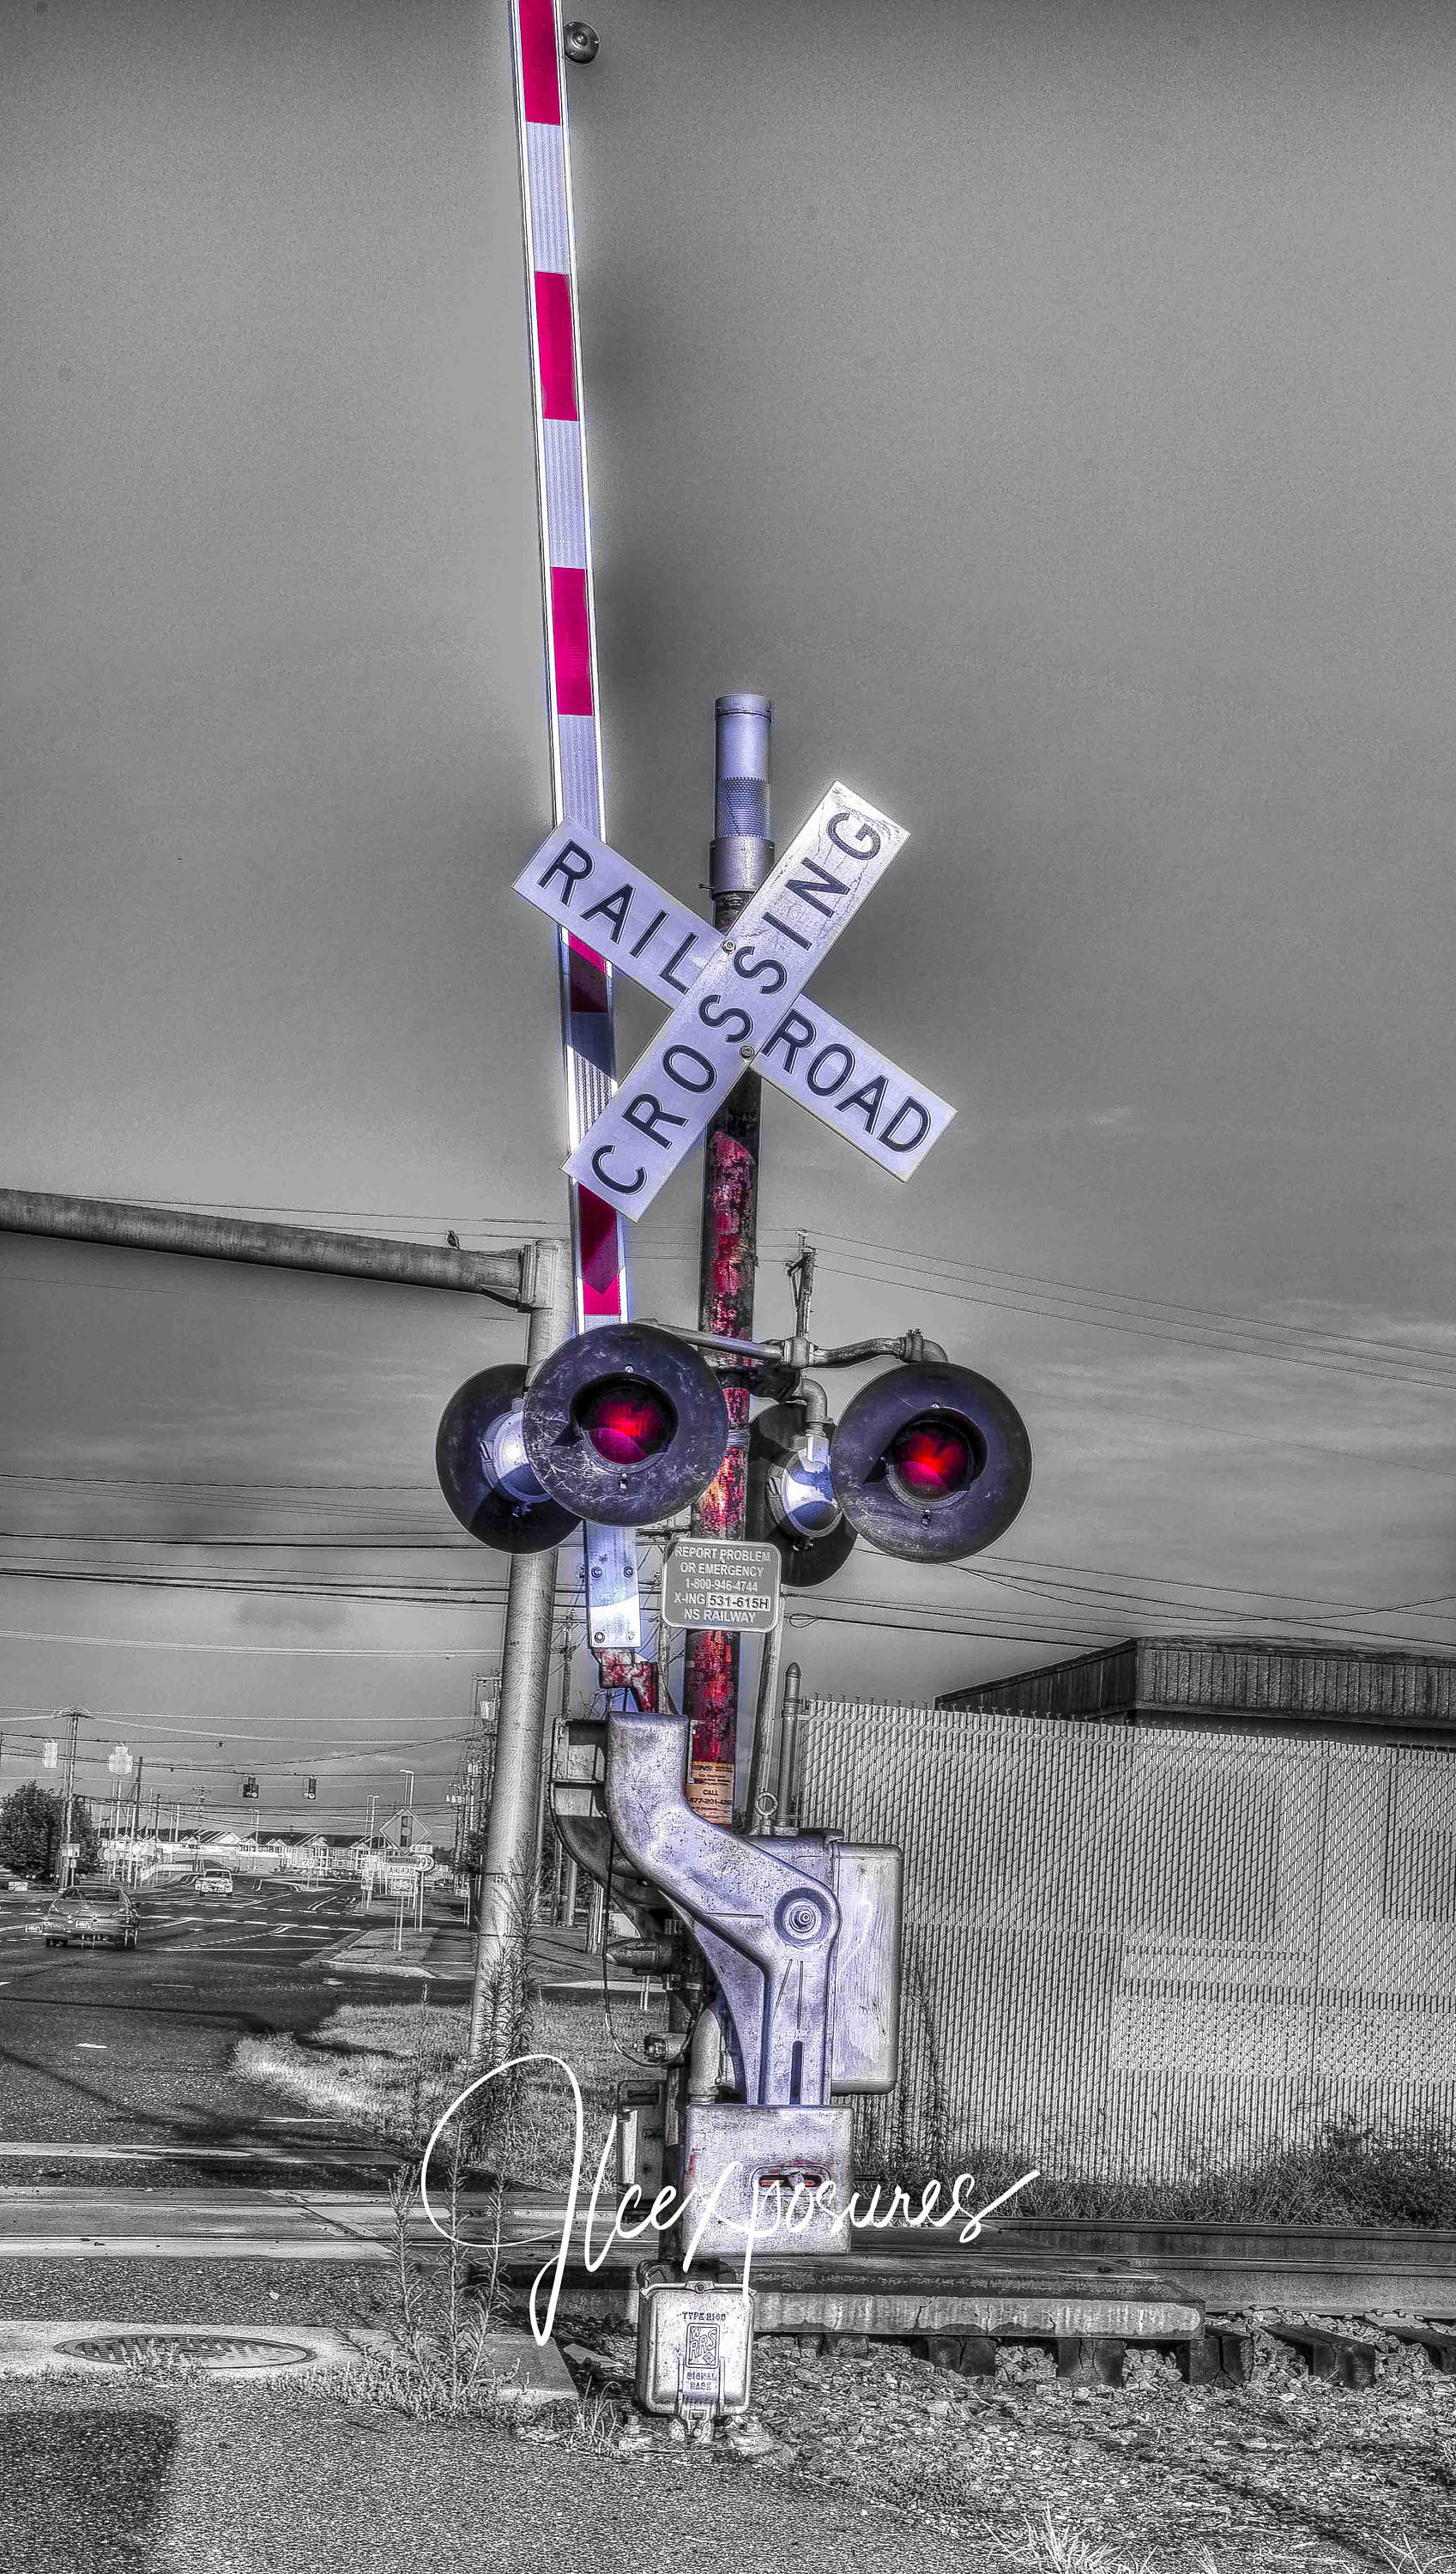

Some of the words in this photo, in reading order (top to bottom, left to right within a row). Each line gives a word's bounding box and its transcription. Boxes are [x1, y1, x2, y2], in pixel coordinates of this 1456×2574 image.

[538, 839, 700, 995] RAIL
[761, 1006, 932, 1153] ROAD
[589, 812, 882, 1195] CROSSING
[674, 1546, 718, 1558] REPORT
[720, 1549, 771, 1562] PROBLEM
[680, 1562, 697, 1574] OR
[698, 1563, 764, 1577] EMERGENCY
[674, 1592, 706, 1605] X-ING
[709, 1595, 770, 1609] 531-615H
[683, 1608, 700, 1621] NS
[704, 1610, 757, 1623] RAILWAY
[682, 2311, 704, 2320] TYPE
